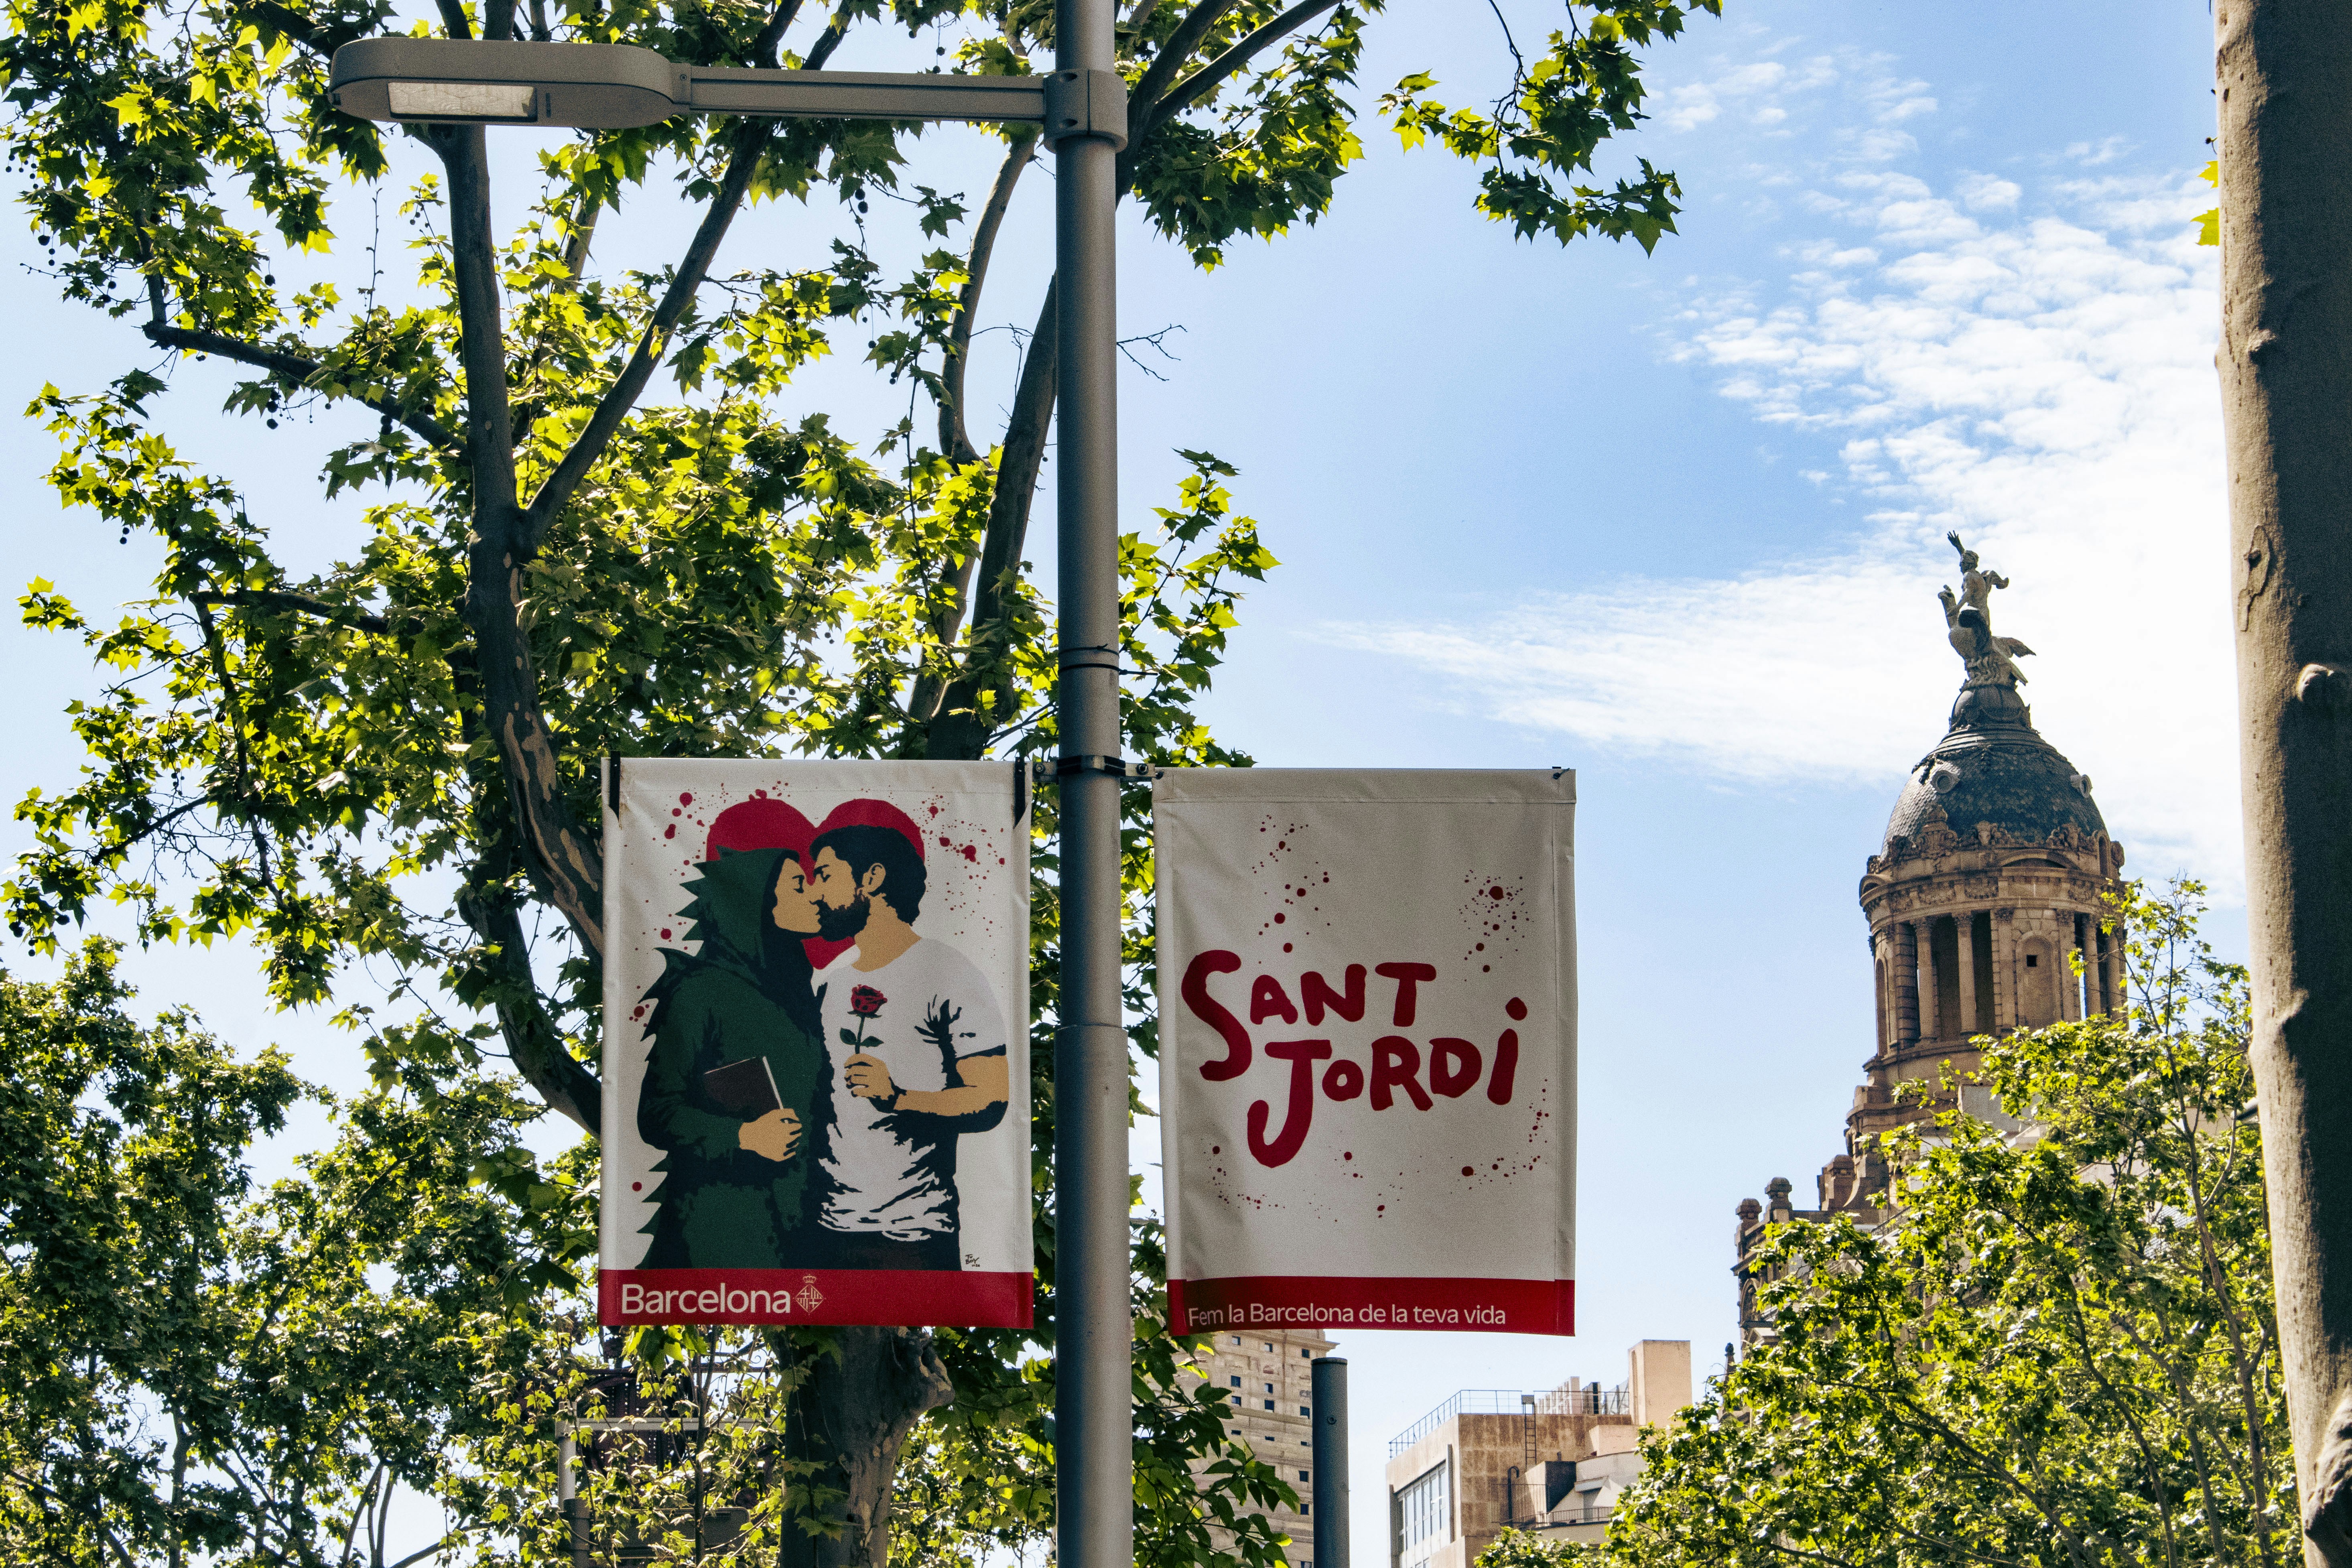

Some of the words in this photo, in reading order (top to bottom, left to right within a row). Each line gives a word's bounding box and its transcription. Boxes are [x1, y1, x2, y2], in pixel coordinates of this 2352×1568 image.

[1181, 950, 1436, 1082] SANT
[622, 1283, 791, 1314] Barcelona
[1189, 1307, 1223, 1326] Fem
[1229, 1304, 1244, 1323] la
[1250, 1303, 1354, 1322] Barcelona
[1359, 1304, 1386, 1323] de
[1392, 1304, 1408, 1323] la
[1413, 1306, 1458, 1323] teva
[1464, 1305, 1505, 1324] vida
